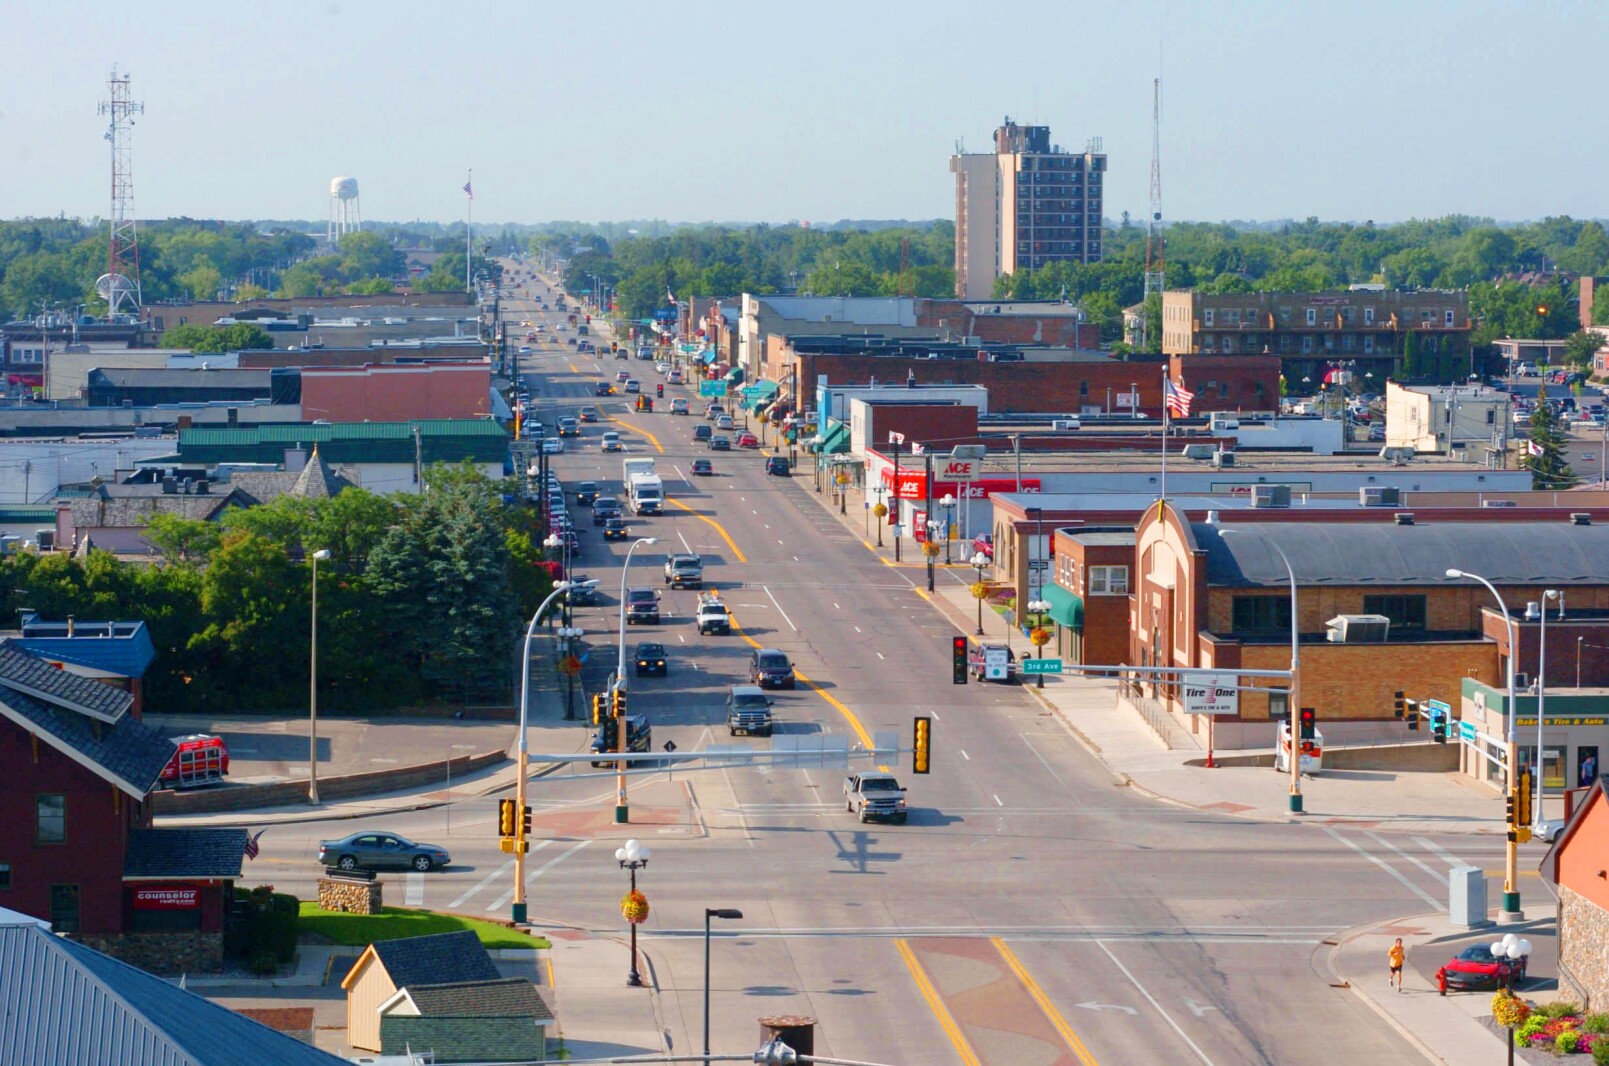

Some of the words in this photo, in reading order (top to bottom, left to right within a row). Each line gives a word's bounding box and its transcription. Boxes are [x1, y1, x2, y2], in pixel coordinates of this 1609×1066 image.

[944, 462, 972, 474] ACE
[900, 481, 919, 492] ACE
[961, 487, 985, 497] ACE
[1186, 689, 1205, 697] Tire
[1215, 688, 1235, 697] One
[137, 891, 195, 900] counselor
